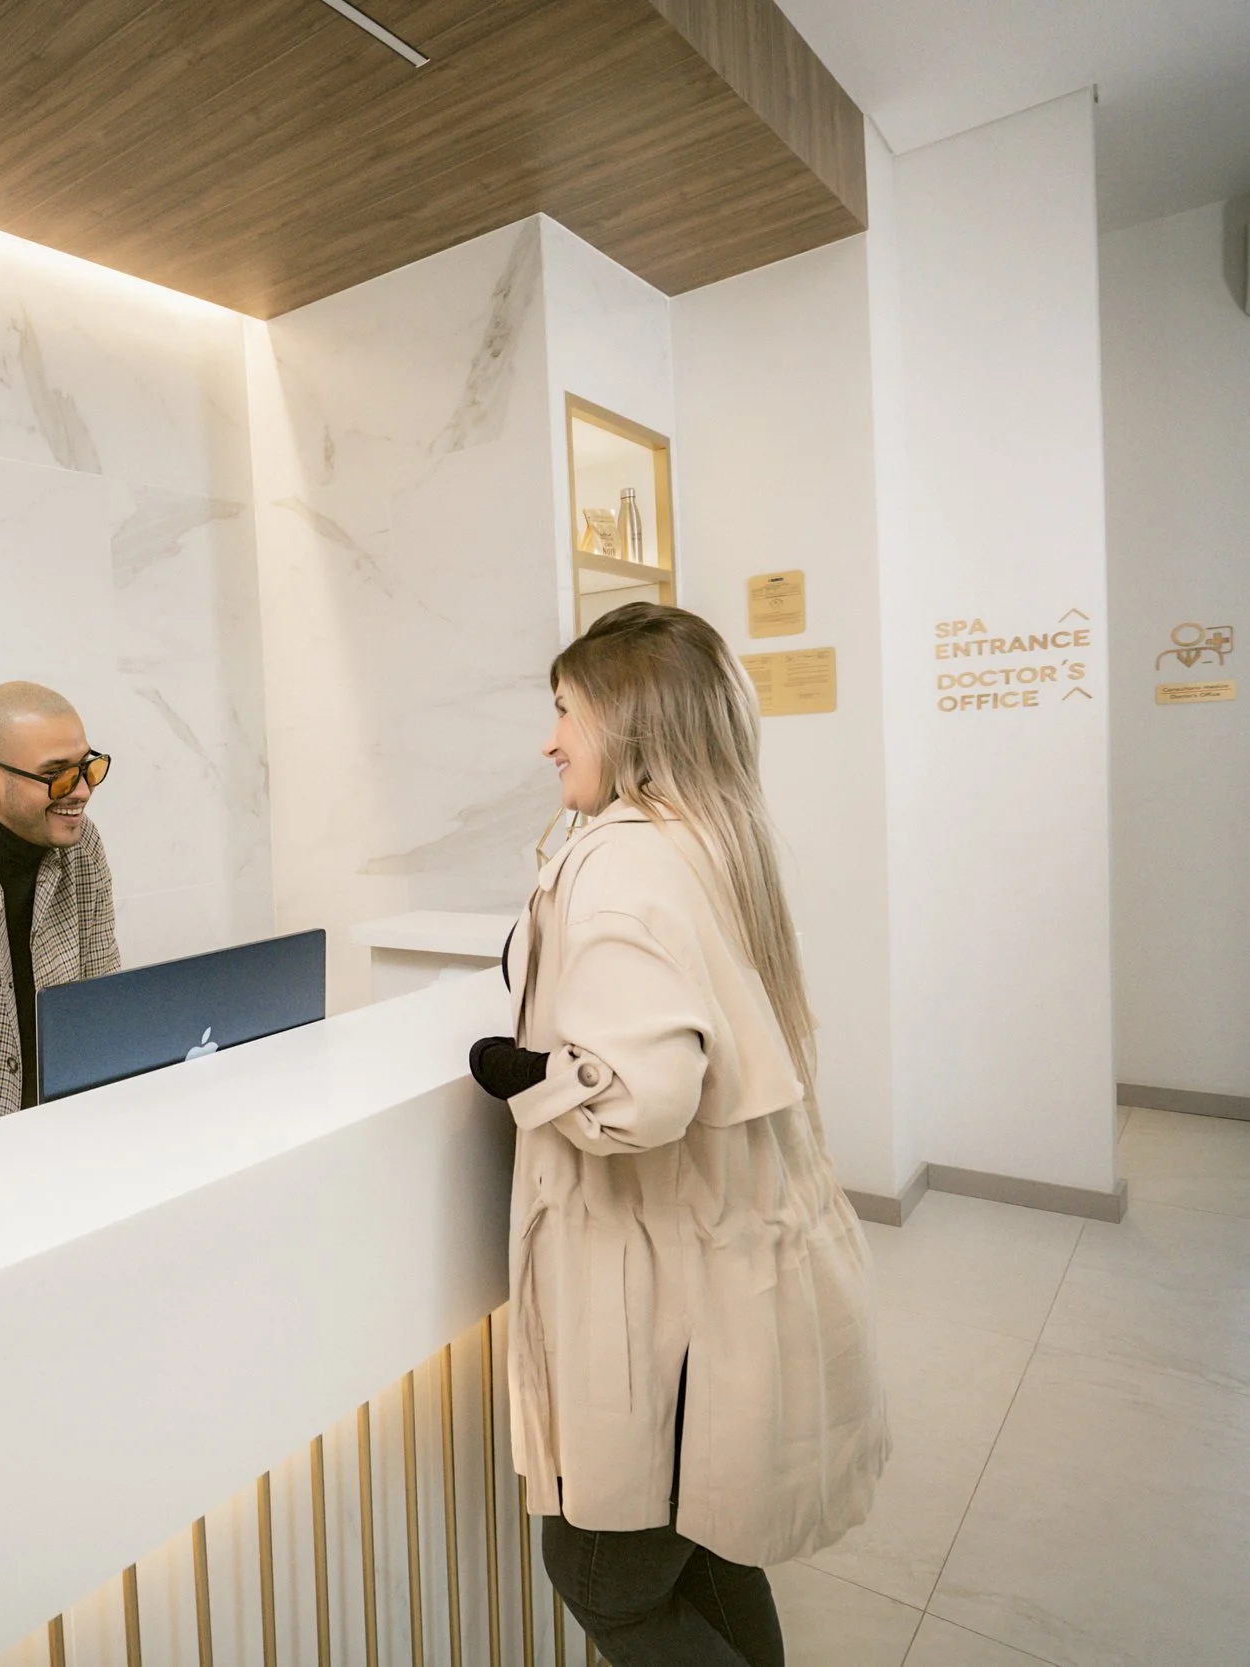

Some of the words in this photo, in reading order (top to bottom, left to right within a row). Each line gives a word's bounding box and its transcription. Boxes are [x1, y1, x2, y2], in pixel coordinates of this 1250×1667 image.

[934, 617, 988, 639] SPA
[934, 628, 1091, 660] ENTRANCE
[937, 658, 1087, 690] DOCTOR'S
[937, 689, 1040, 713] OFFICE
